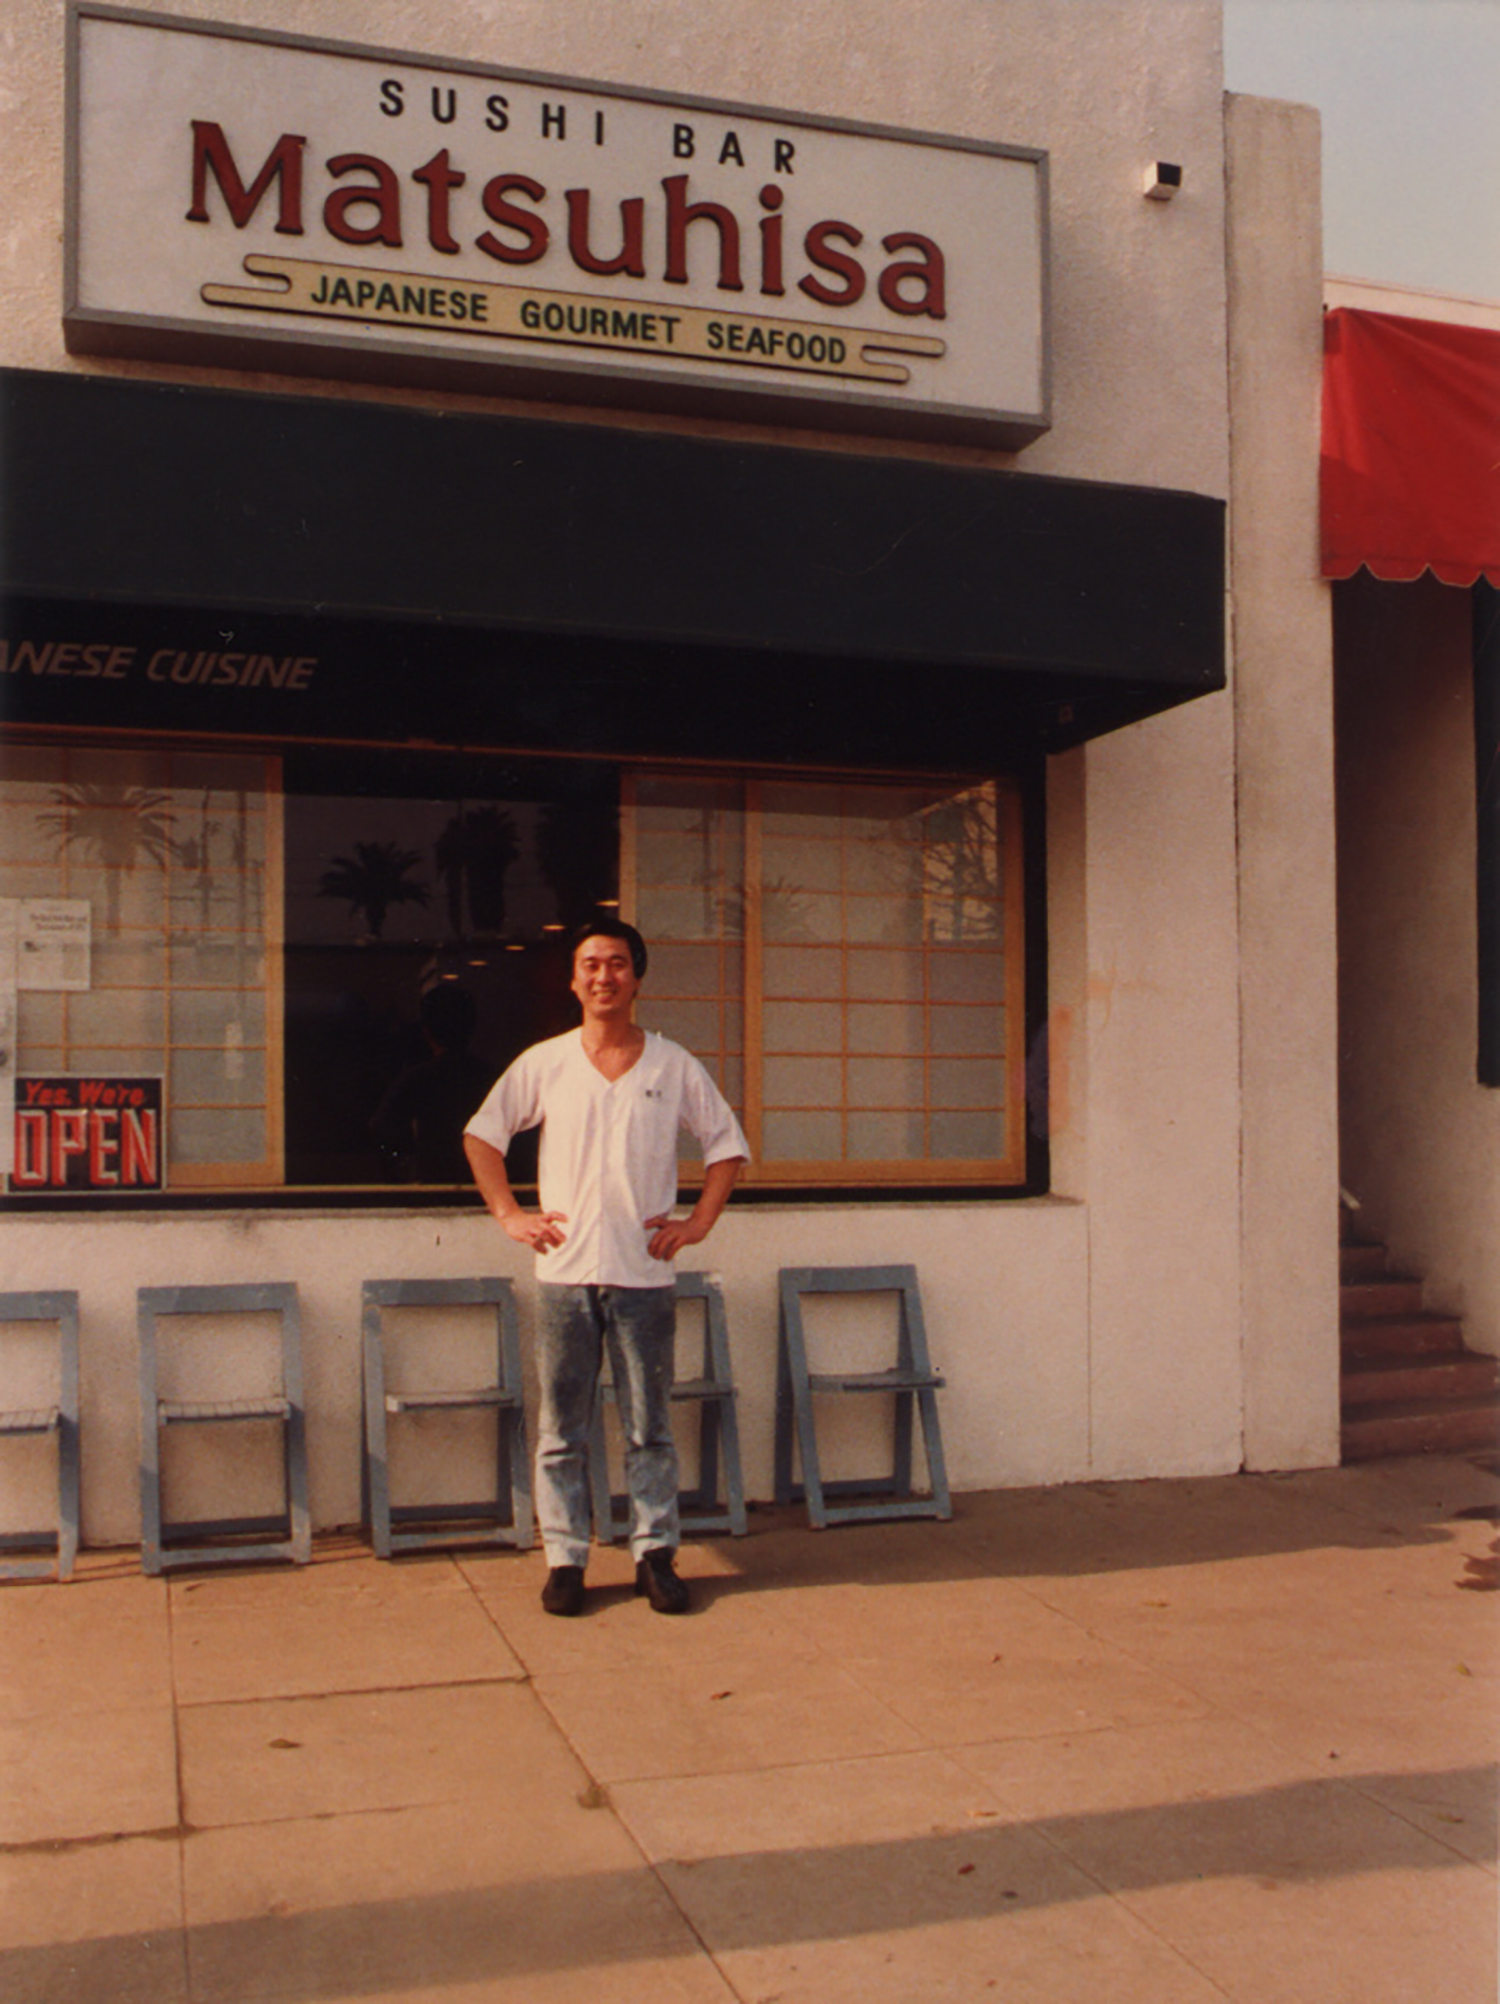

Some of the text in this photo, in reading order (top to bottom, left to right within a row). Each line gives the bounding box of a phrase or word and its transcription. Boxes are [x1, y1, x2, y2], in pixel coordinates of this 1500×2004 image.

[379, 79, 796, 175] SUSHI BAR
[185, 119, 947, 320] Matsuhisa
[311, 275, 847, 365] JAPANESE GOURMET SEAFOOD
[146, 650, 318, 689] CUISINE
[14, 1109, 157, 1186] OPEN
